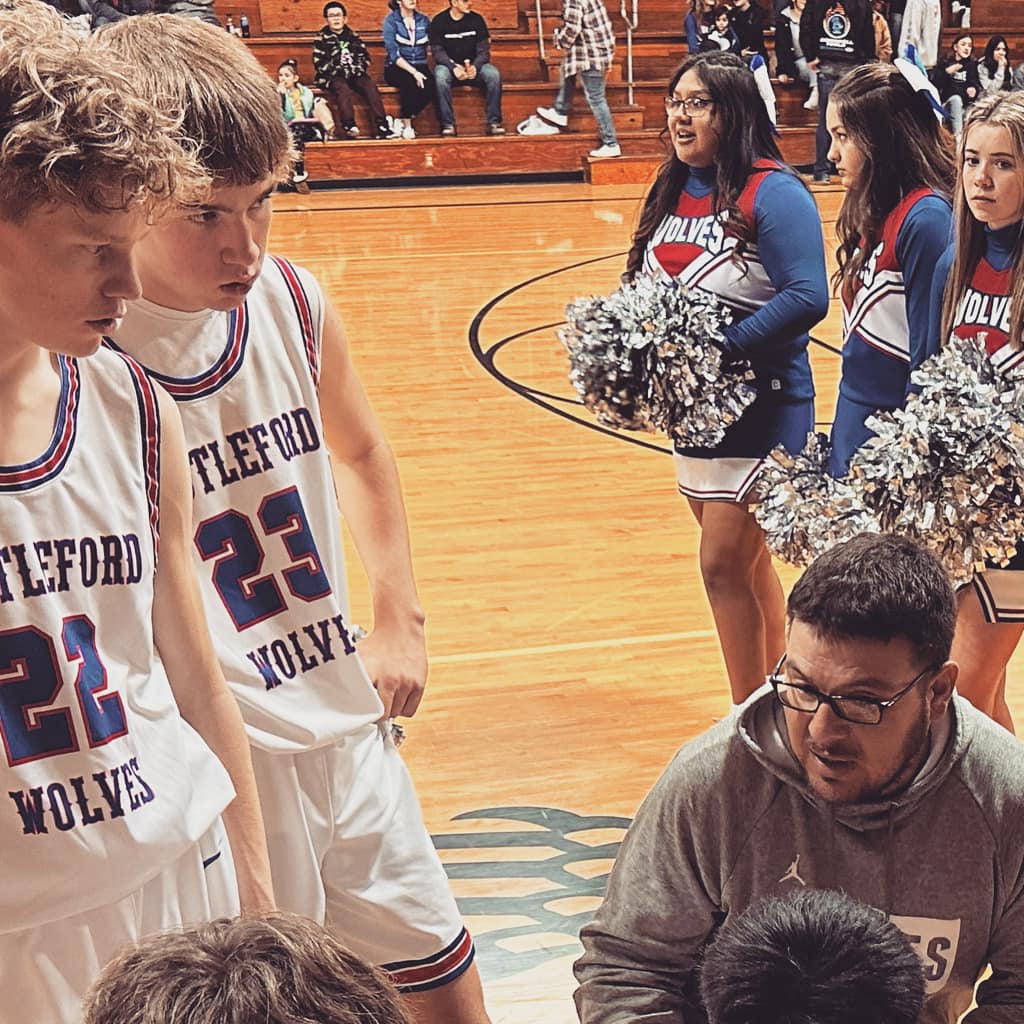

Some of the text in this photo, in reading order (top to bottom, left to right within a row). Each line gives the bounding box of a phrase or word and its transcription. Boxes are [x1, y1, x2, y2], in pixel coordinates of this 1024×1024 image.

[189, 408, 320, 495] TLEFORD
[194, 485, 332, 632] 23
[0, 613, 128, 767] 22
[8, 756, 156, 836] WOLVES
